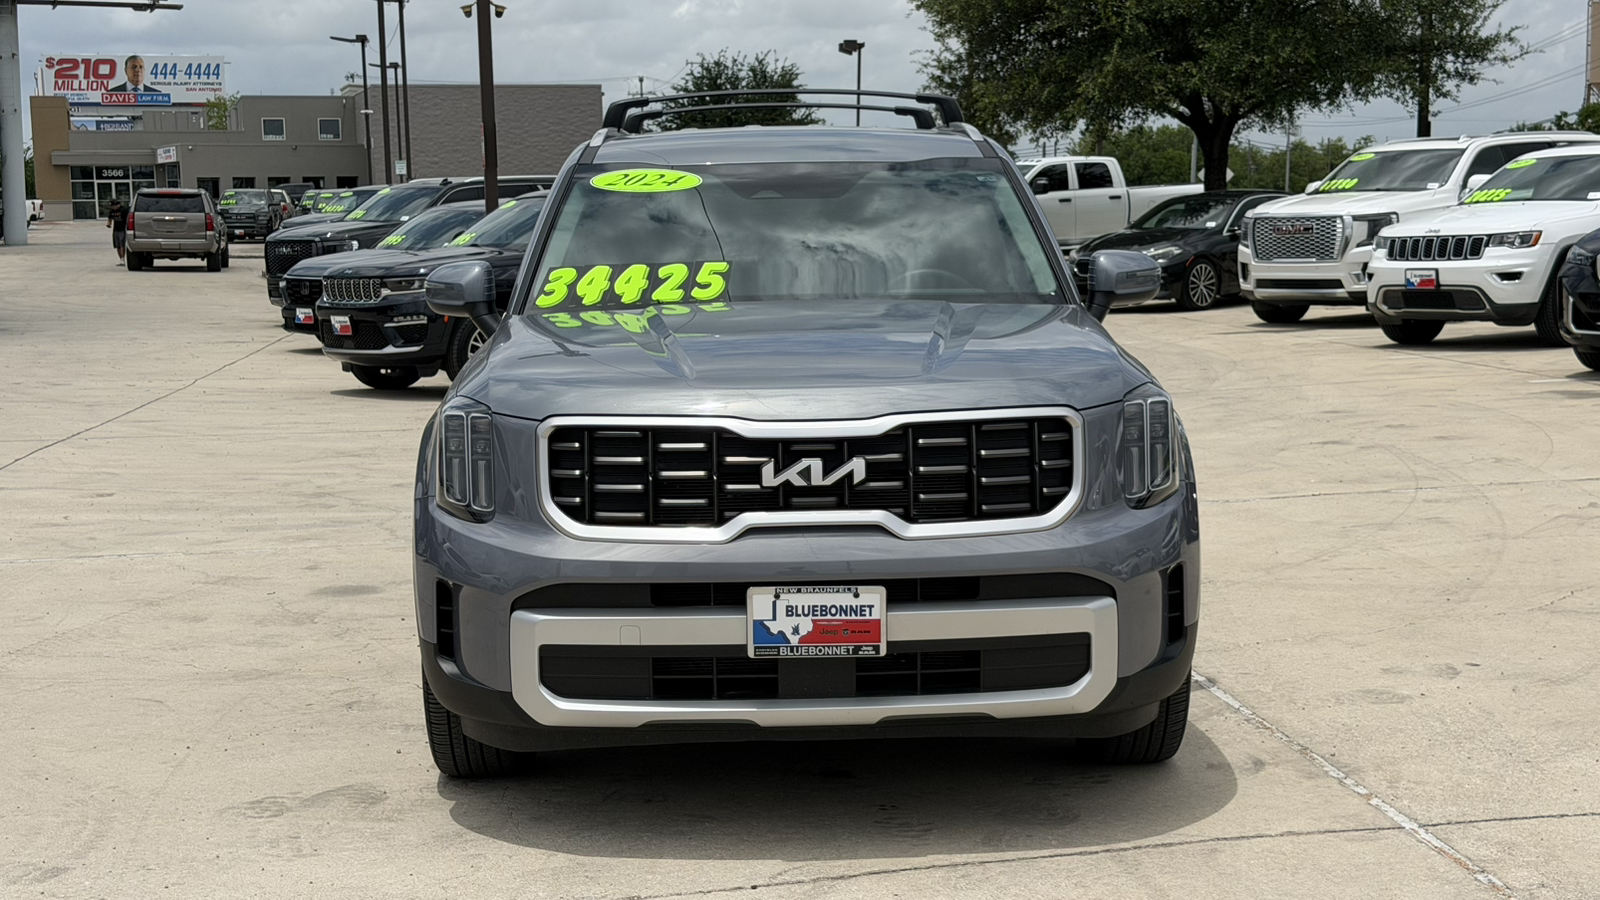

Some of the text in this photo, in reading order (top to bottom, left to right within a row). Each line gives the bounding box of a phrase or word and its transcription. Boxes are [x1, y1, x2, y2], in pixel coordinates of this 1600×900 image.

[45, 56, 117, 80] $210
[150, 62, 221, 80] 444-4444
[54, 80, 110, 92] MILLION
[103, 94, 135, 103] DAVIS
[102, 169, 124, 177] 3566
[603, 173, 689, 187] 2024
[1274, 224, 1314, 235] GMC
[535, 261, 730, 308] 34425
[800, 586, 857, 594] BRAUNFELS
[785, 604, 875, 617] BLUEBONNET
[820, 628, 839, 637] Jeep
[779, 646, 855, 656] BLUEBONNET
